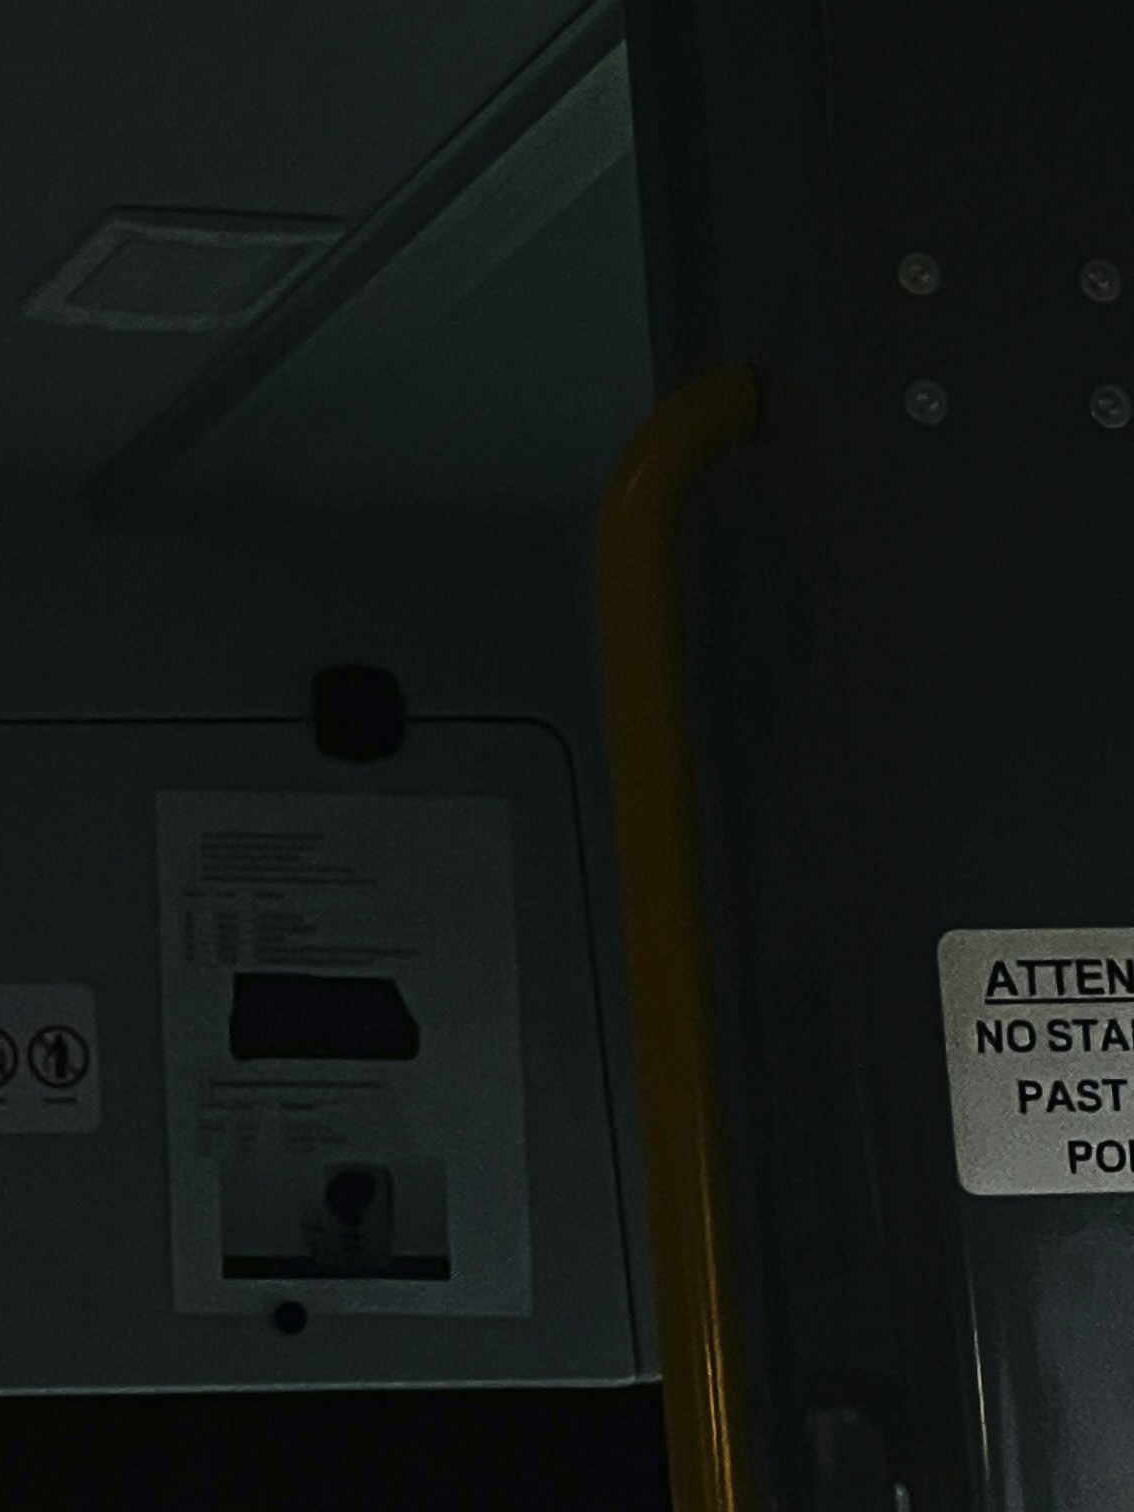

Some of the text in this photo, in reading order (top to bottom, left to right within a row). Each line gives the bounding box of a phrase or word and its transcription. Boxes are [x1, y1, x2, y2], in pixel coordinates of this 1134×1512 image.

[976, 1018, 1134, 1054] NO STA
[1017, 1078, 1128, 1115] PAST
